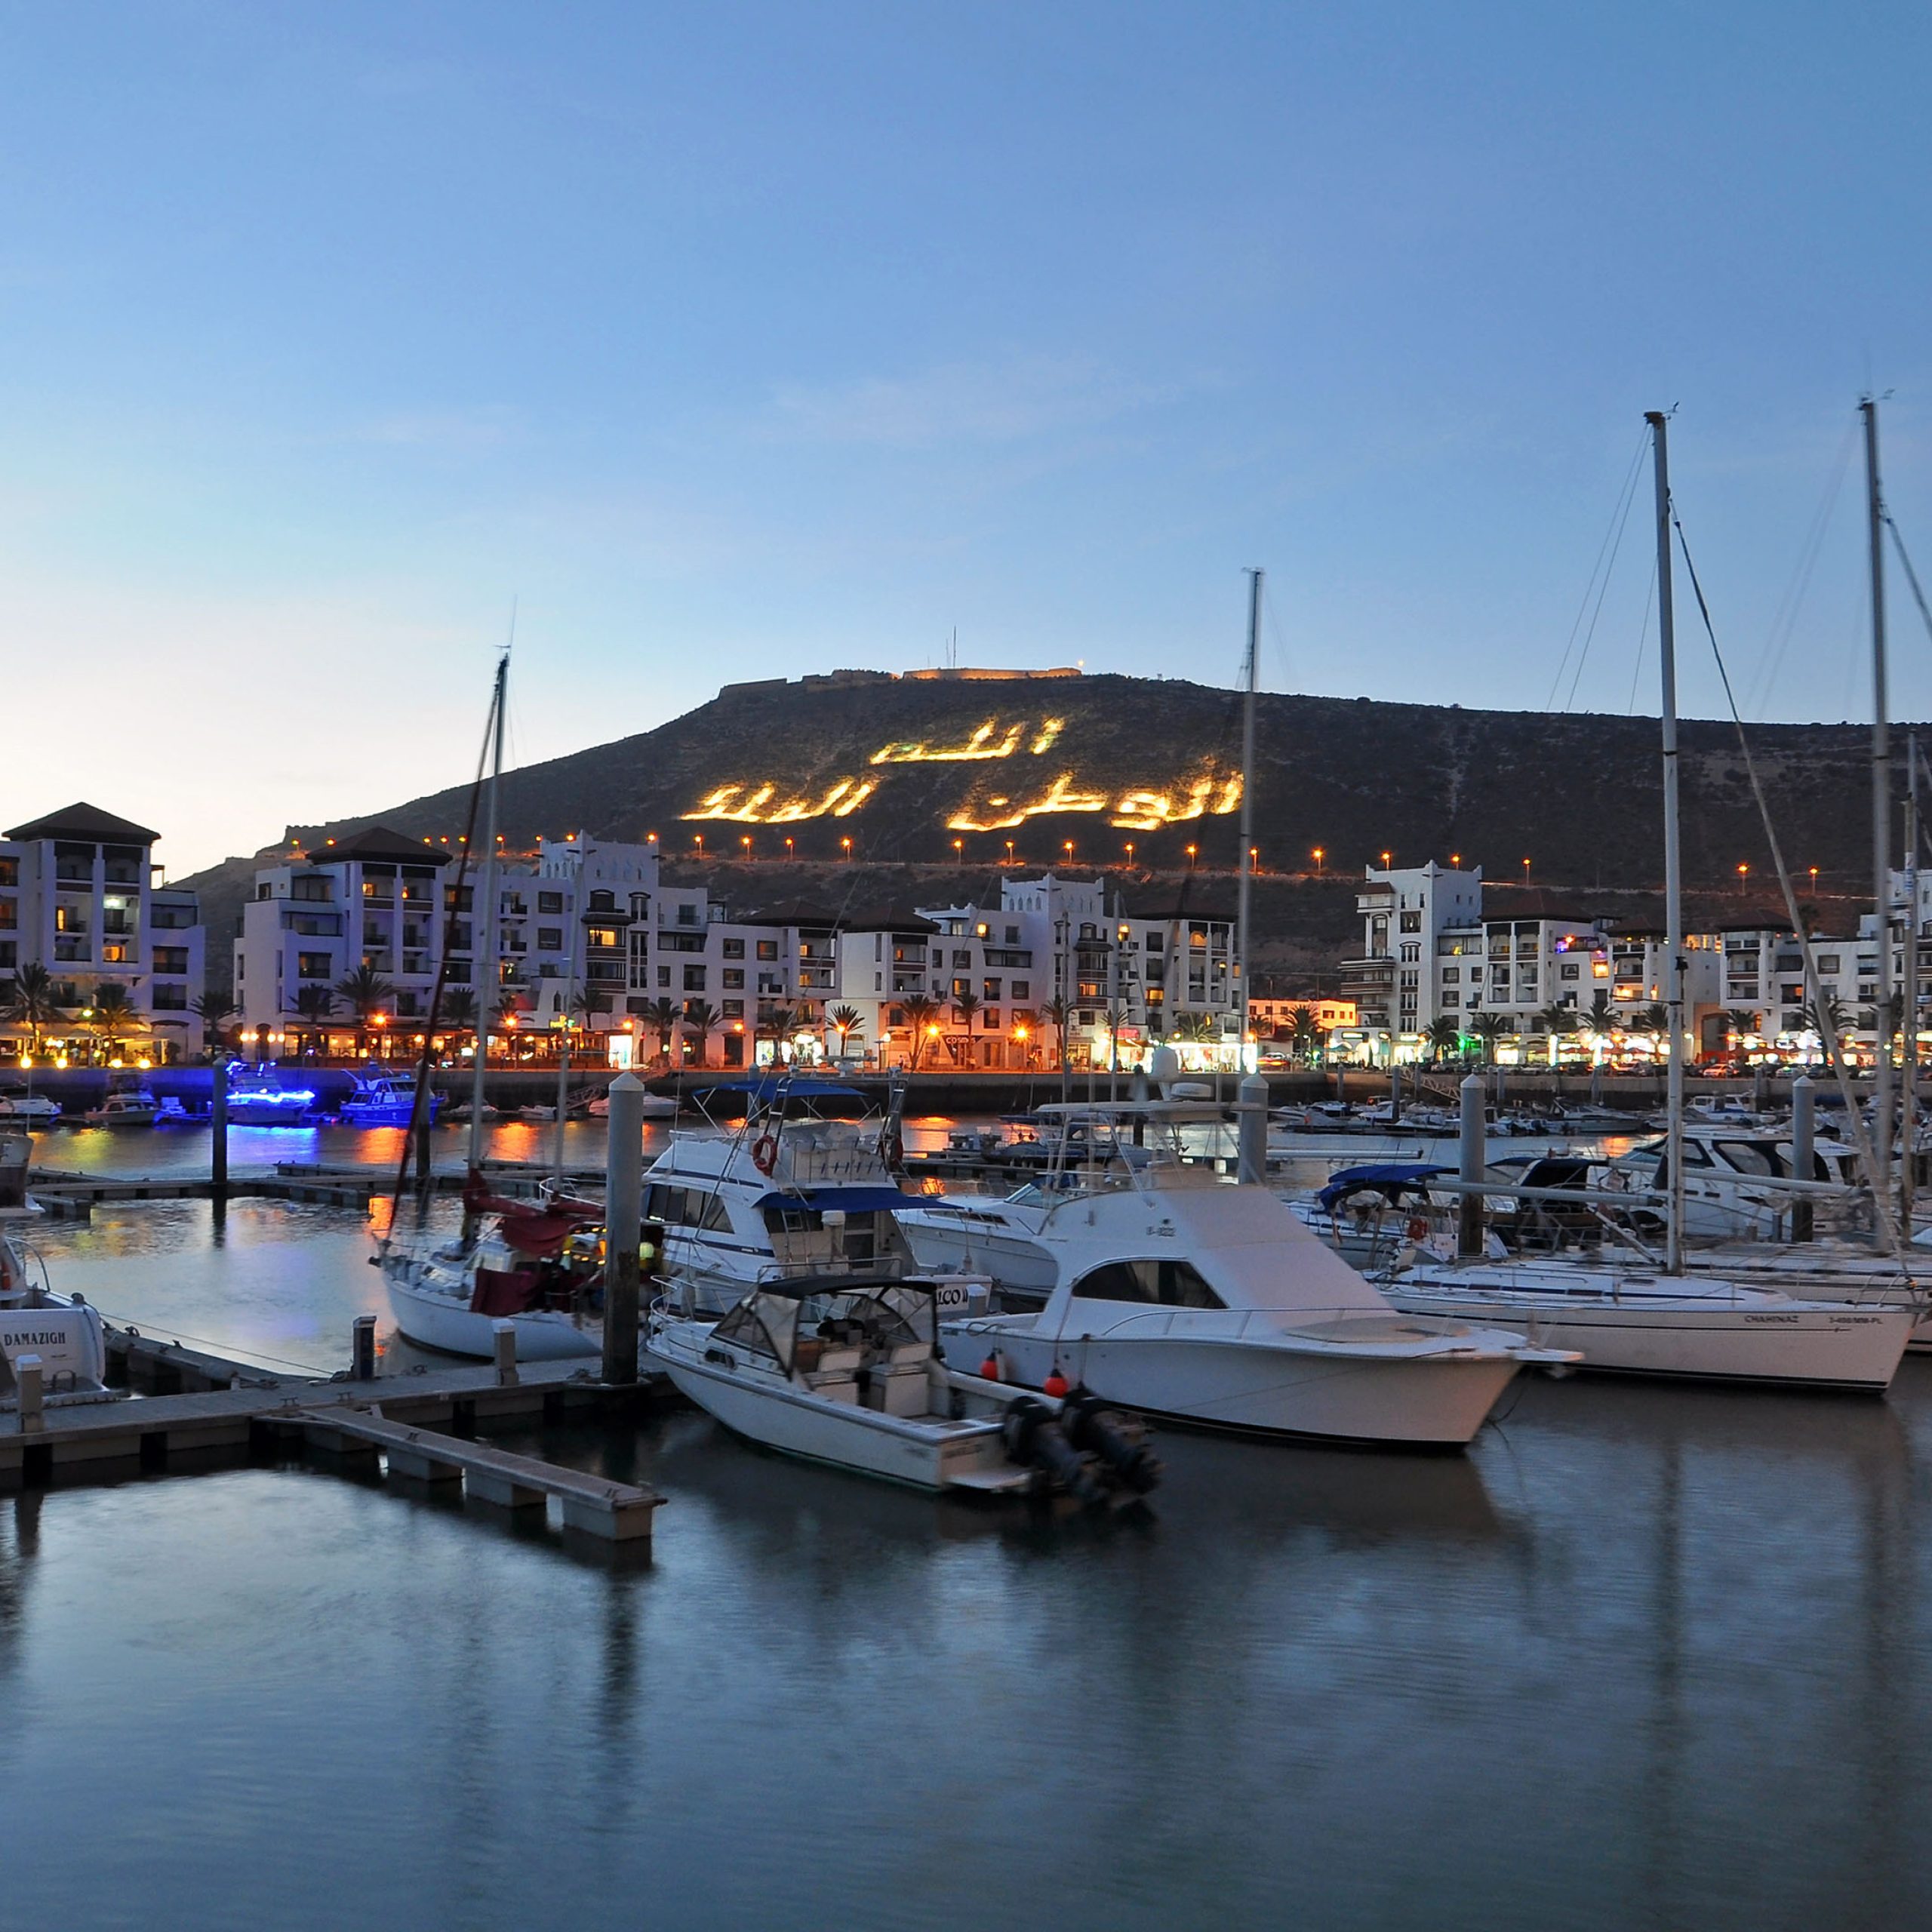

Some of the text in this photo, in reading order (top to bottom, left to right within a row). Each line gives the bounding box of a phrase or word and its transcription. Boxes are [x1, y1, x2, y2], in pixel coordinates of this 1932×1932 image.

[869, 717, 1064, 764] الله
[679, 768, 1244, 831] الوطن الملك
[946, 1036, 977, 1044] COSMS
